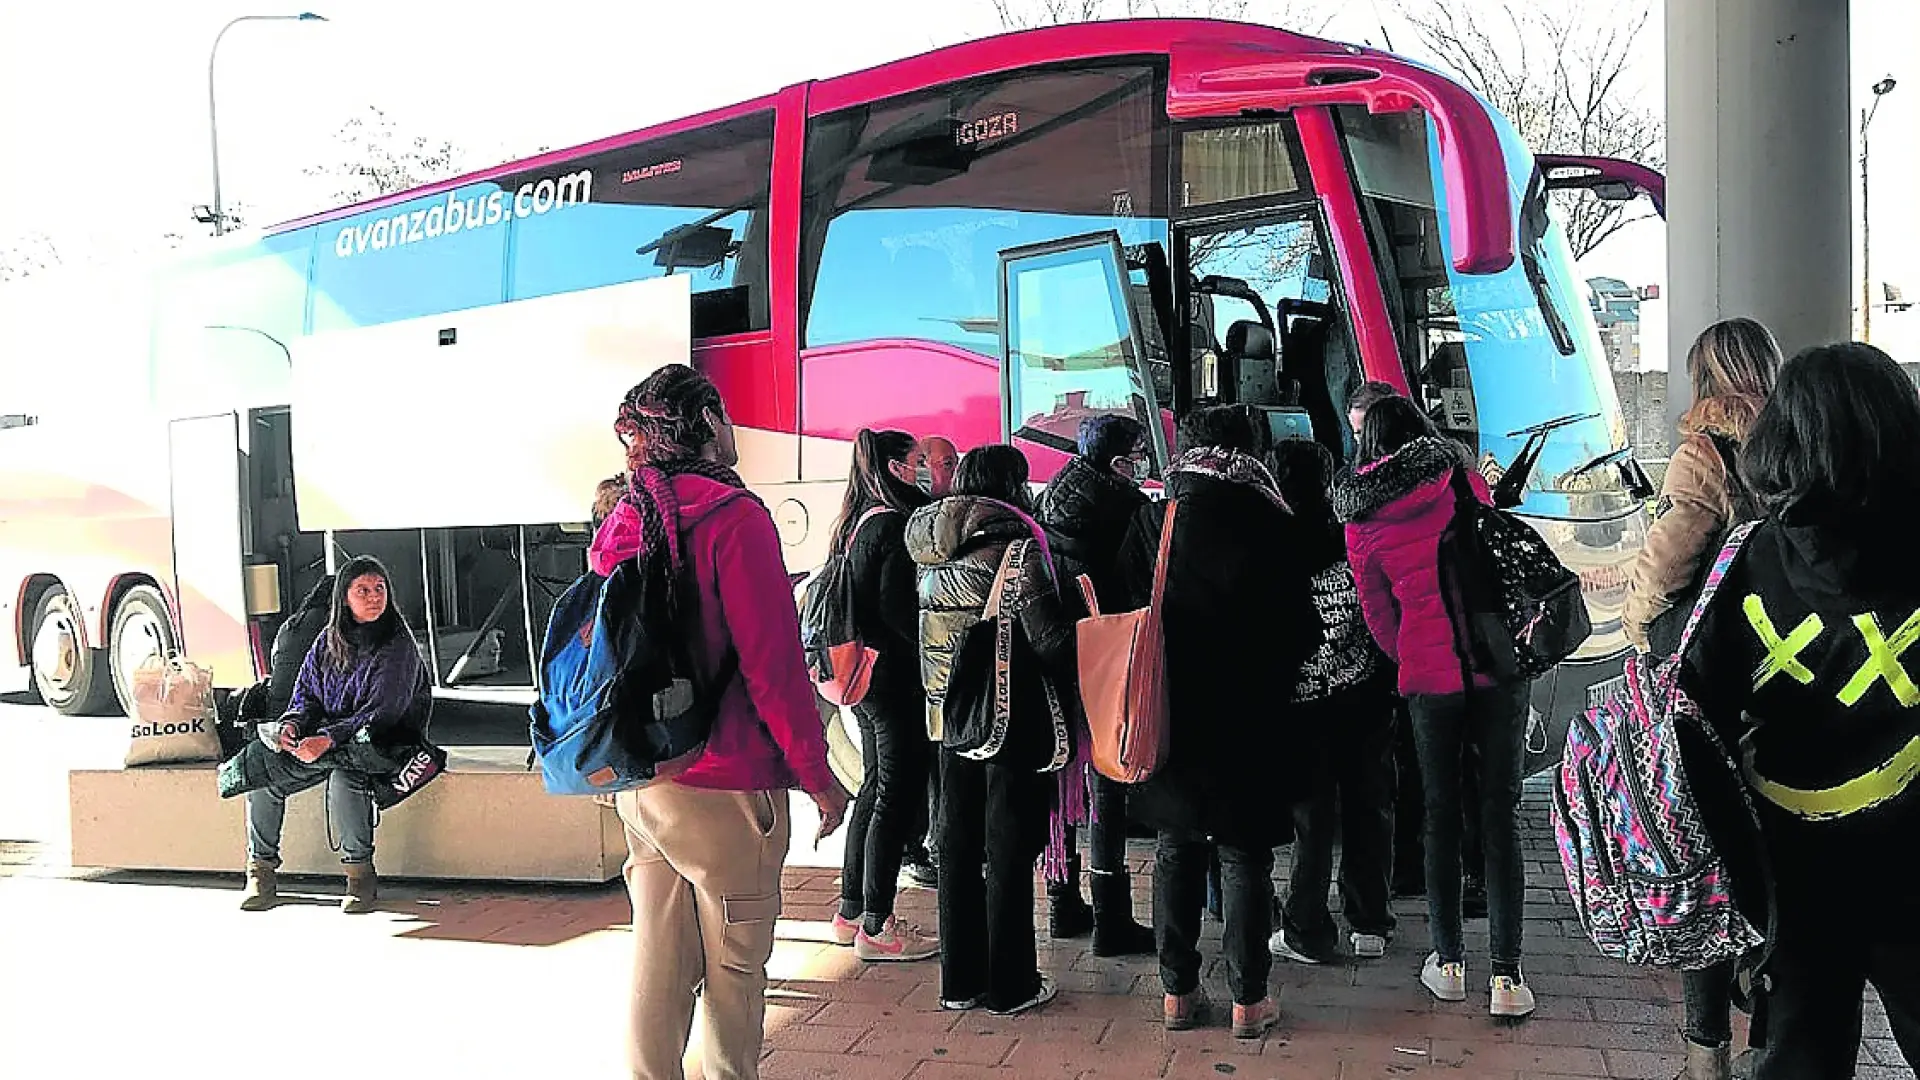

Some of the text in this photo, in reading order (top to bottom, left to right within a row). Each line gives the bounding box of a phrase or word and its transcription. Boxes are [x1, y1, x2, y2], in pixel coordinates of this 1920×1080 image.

[956, 112, 1017, 146] GOZA
[335, 169, 593, 257] avanzabus.com
[392, 751, 430, 792] VANS
